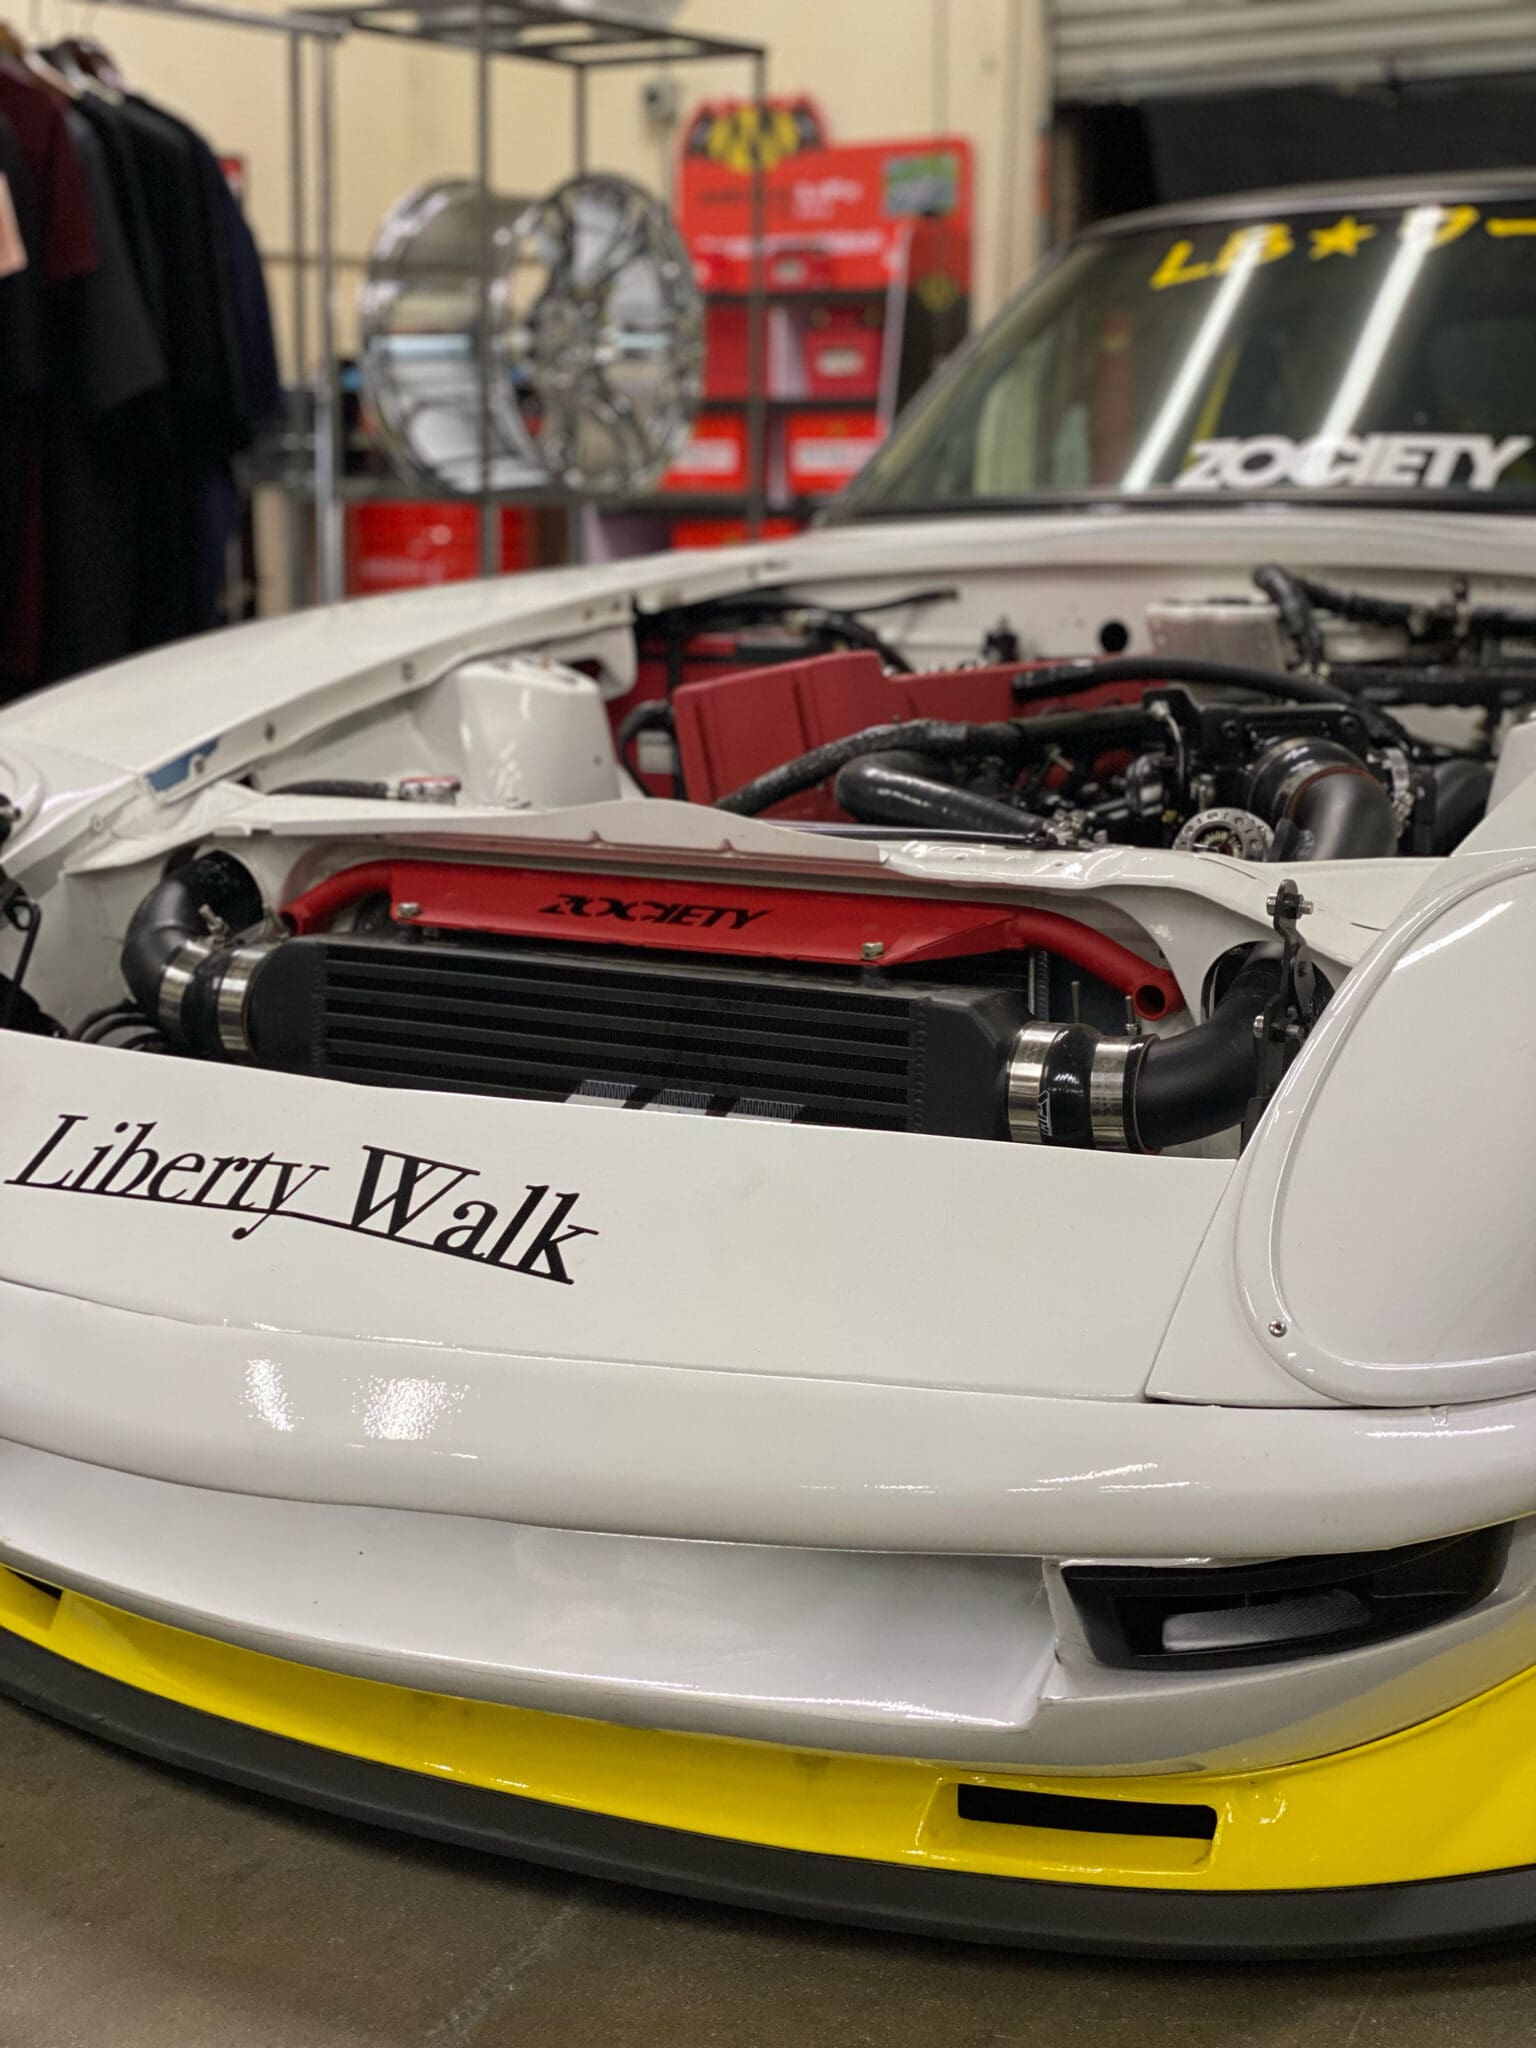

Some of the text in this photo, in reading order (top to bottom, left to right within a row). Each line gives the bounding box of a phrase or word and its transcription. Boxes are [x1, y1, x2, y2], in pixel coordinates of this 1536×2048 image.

[1172, 432, 1533, 491] ZOCIETY
[3, 1113, 600, 1285] Liberty Walk
